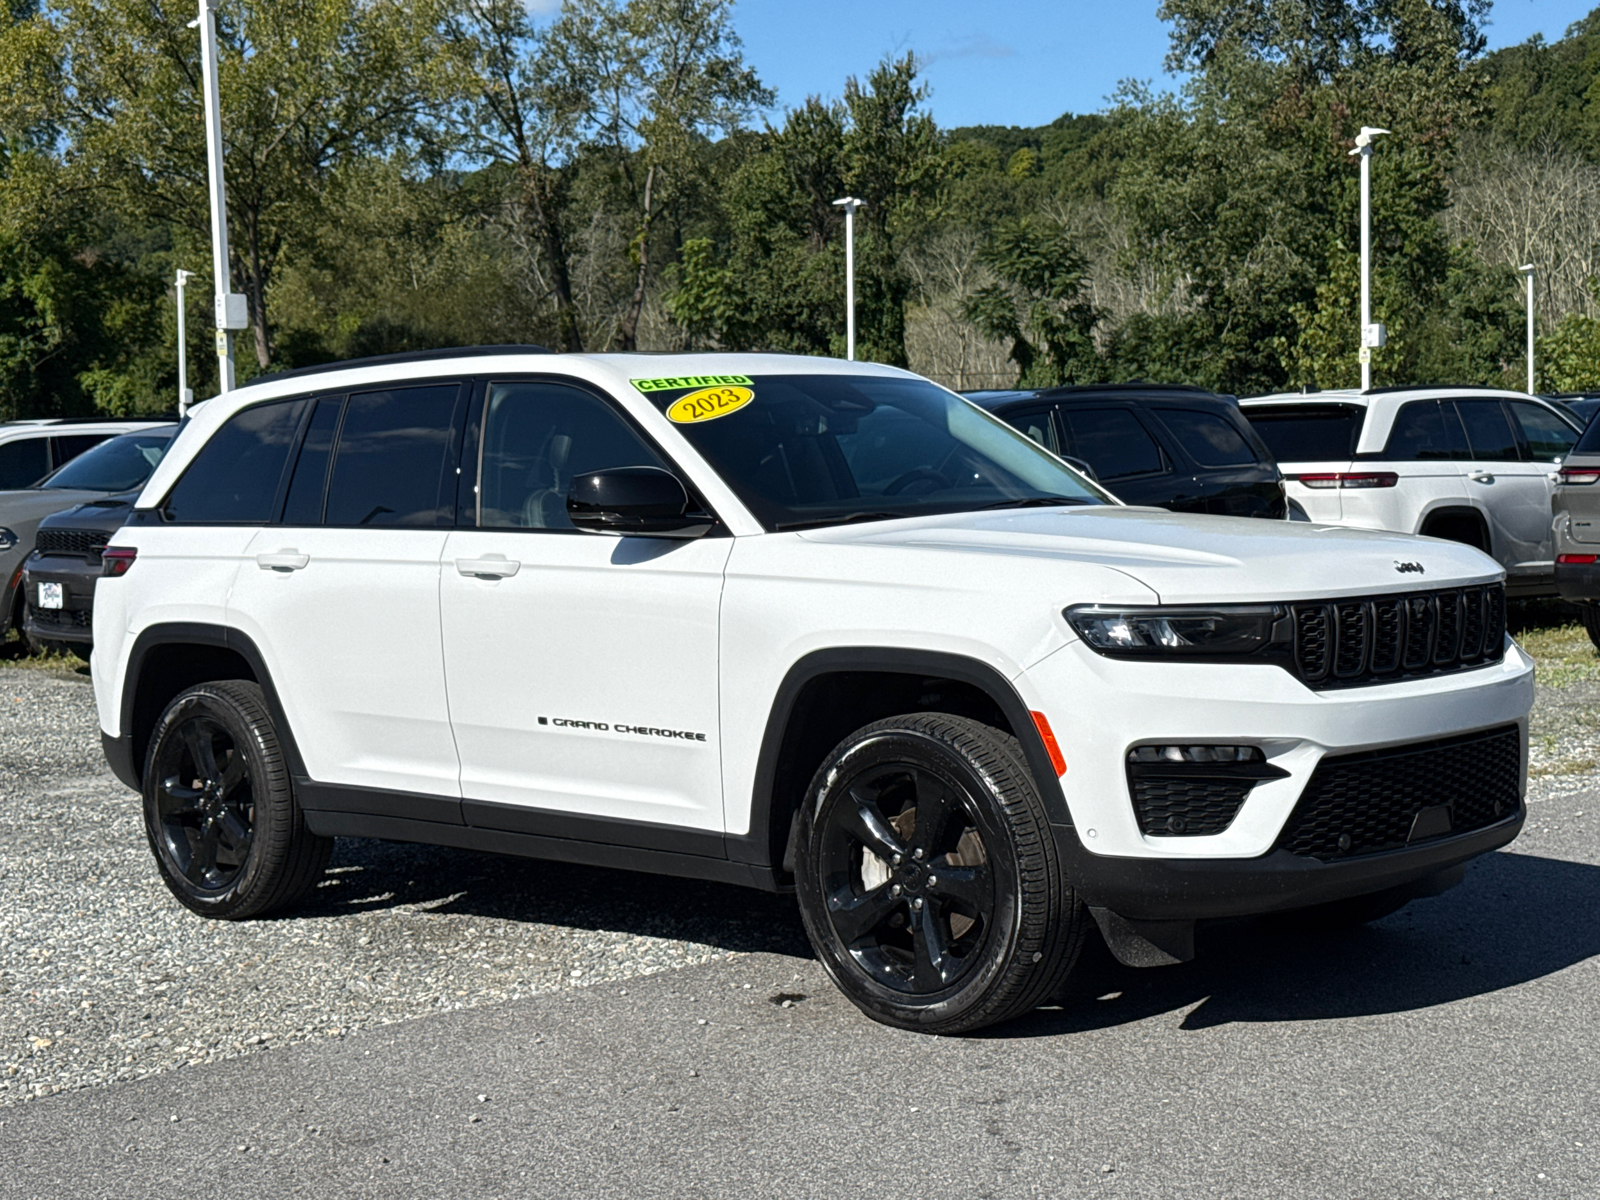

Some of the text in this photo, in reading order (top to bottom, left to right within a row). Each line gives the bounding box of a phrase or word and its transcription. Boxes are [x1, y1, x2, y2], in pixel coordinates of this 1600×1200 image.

[638, 376, 747, 390] CERTIFIED
[682, 389, 741, 419] 2023
[552, 718, 707, 742] GRAND CHEROKEE
